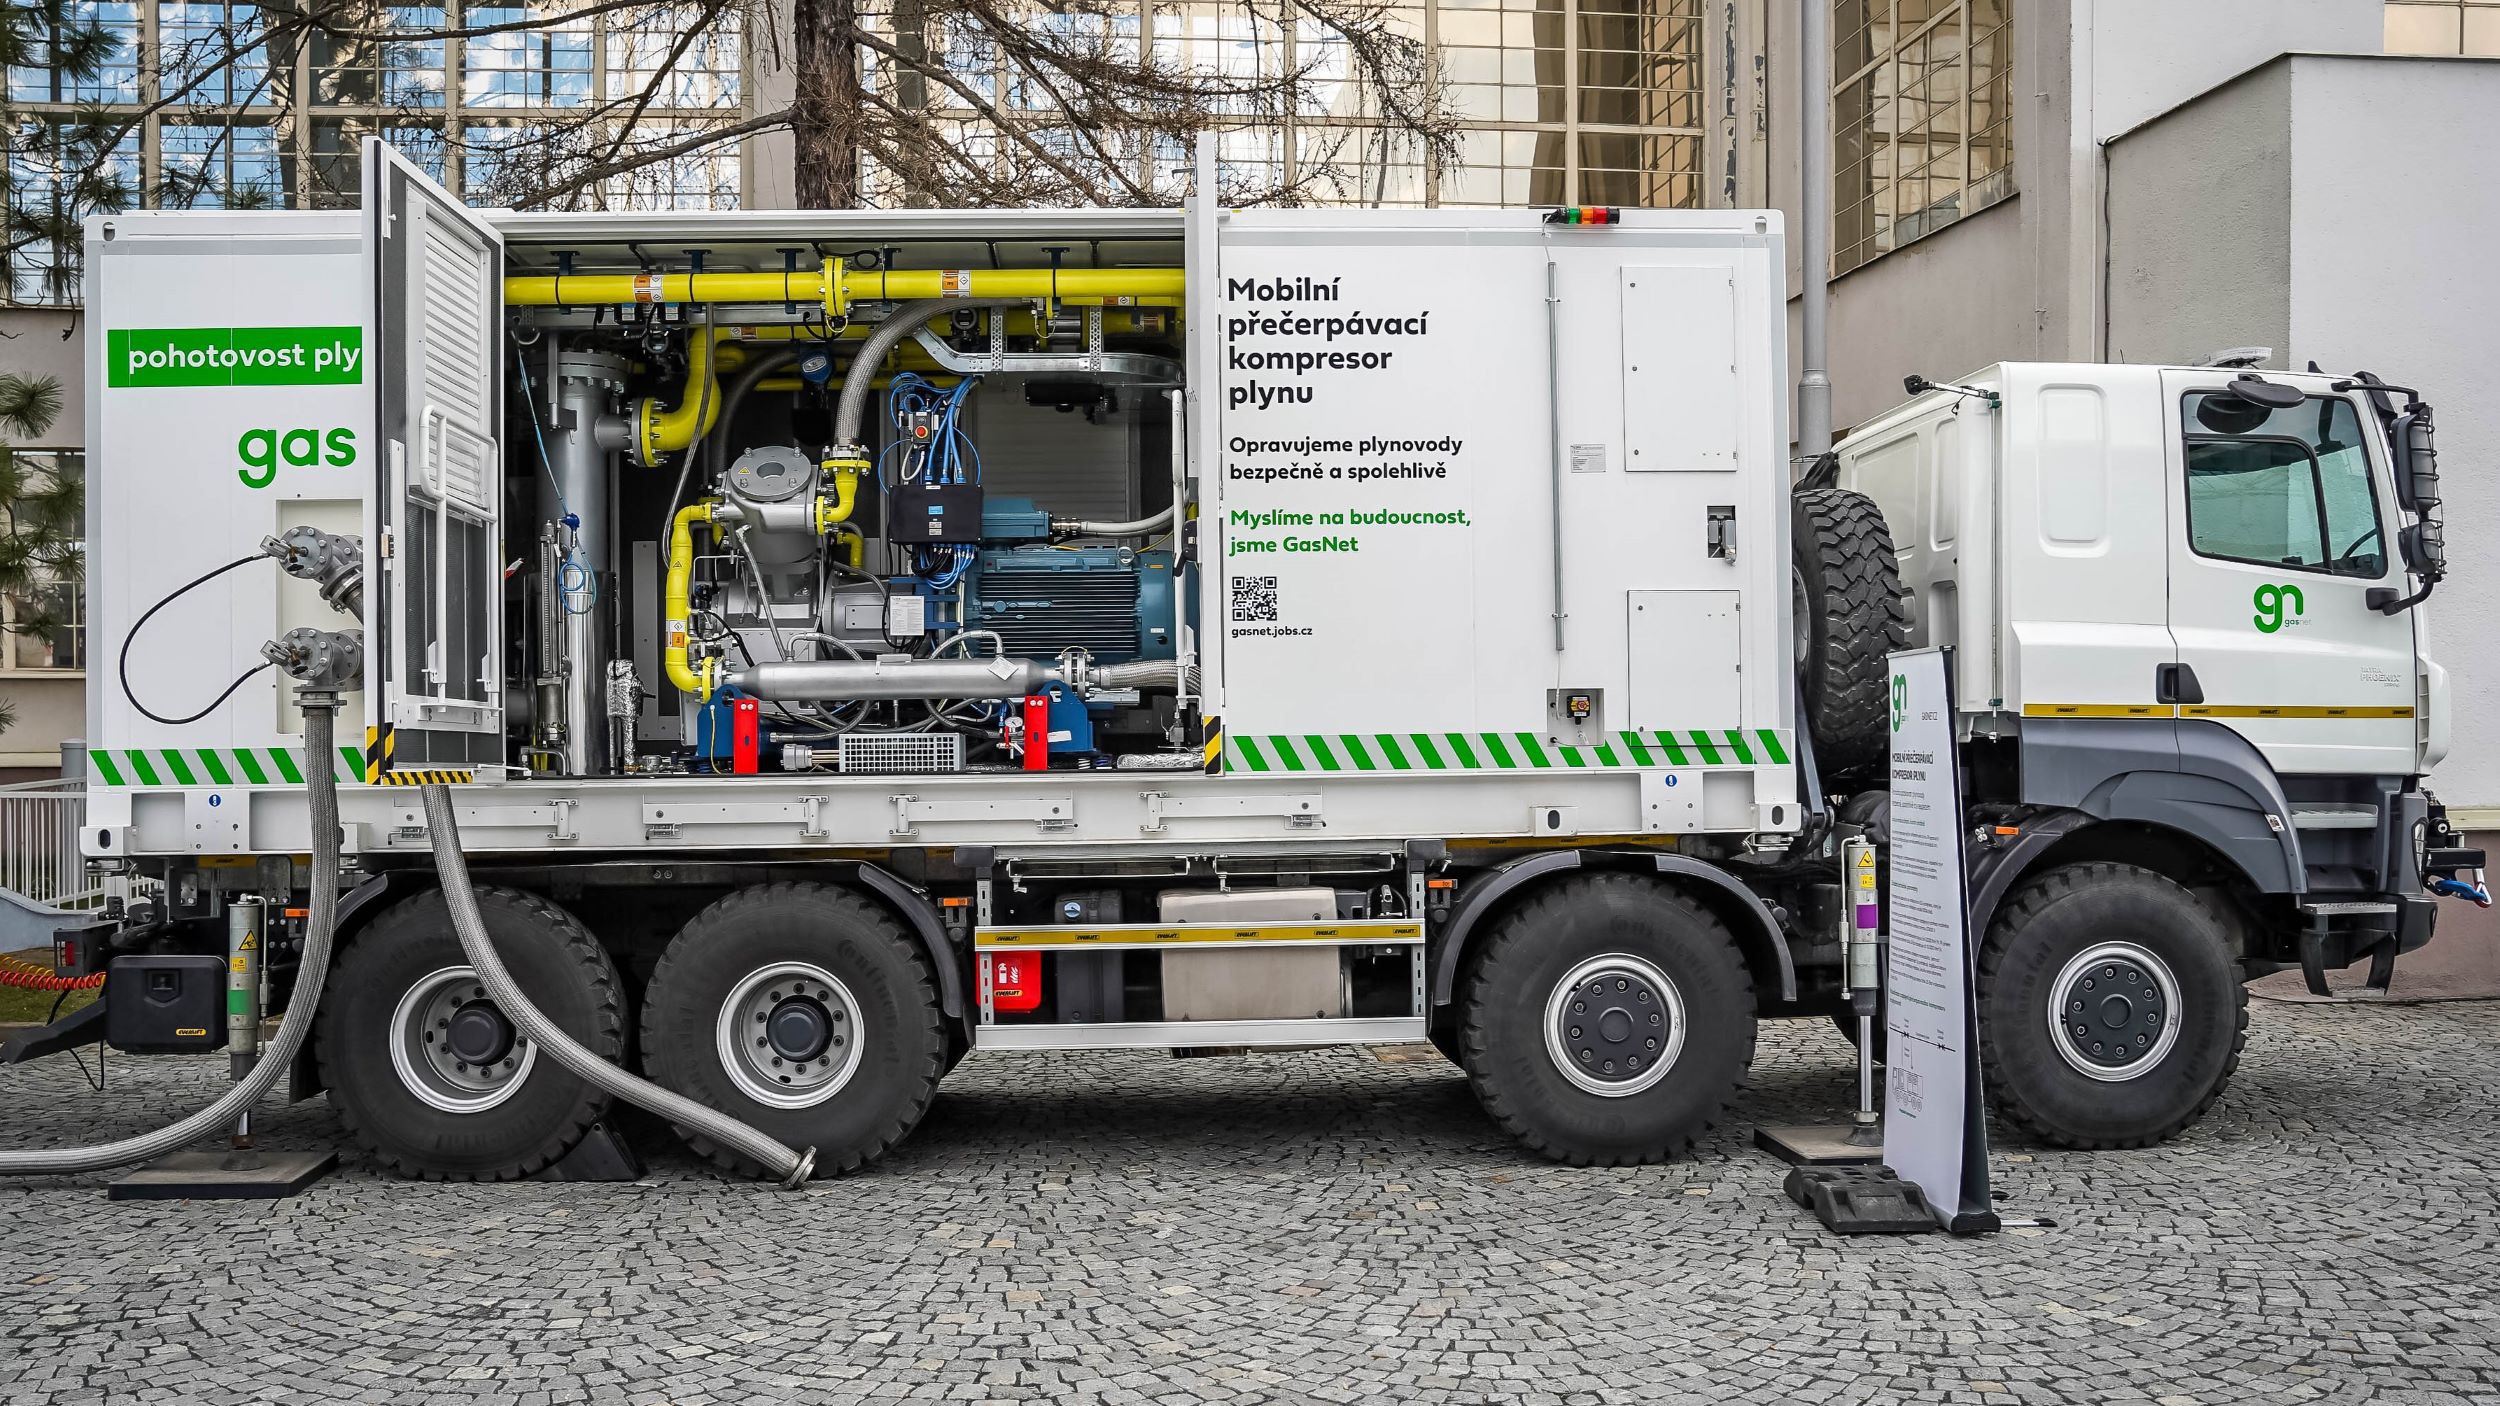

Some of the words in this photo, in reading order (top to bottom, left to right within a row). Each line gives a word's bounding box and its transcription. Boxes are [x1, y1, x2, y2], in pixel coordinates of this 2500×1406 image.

[1228, 276, 1342, 301] Mobilní
[1228, 310, 1430, 341] přečerpávací
[129, 343, 306, 375] pohotovost
[1229, 345, 1393, 375] kompresor
[1229, 379, 1313, 410] plynu
[1229, 435, 1353, 456] Opravujeme
[1359, 435, 1463, 456] plynovody
[238, 427, 357, 489] gas
[1230, 462, 1324, 484] bezpečně
[1329, 467, 1342, 479] a
[1347, 461, 1447, 483] spolehlivě
[1230, 508, 1313, 530] Myslíme
[1319, 512, 1344, 525] na
[1350, 508, 1471, 528] budoucnost,
[1229, 536, 1277, 557] jsme
[1282, 536, 1359, 554] GasNet
[1231, 625, 1313, 639] gasnet.jobs.cz
[2284, 617, 2312, 628] gasnet
